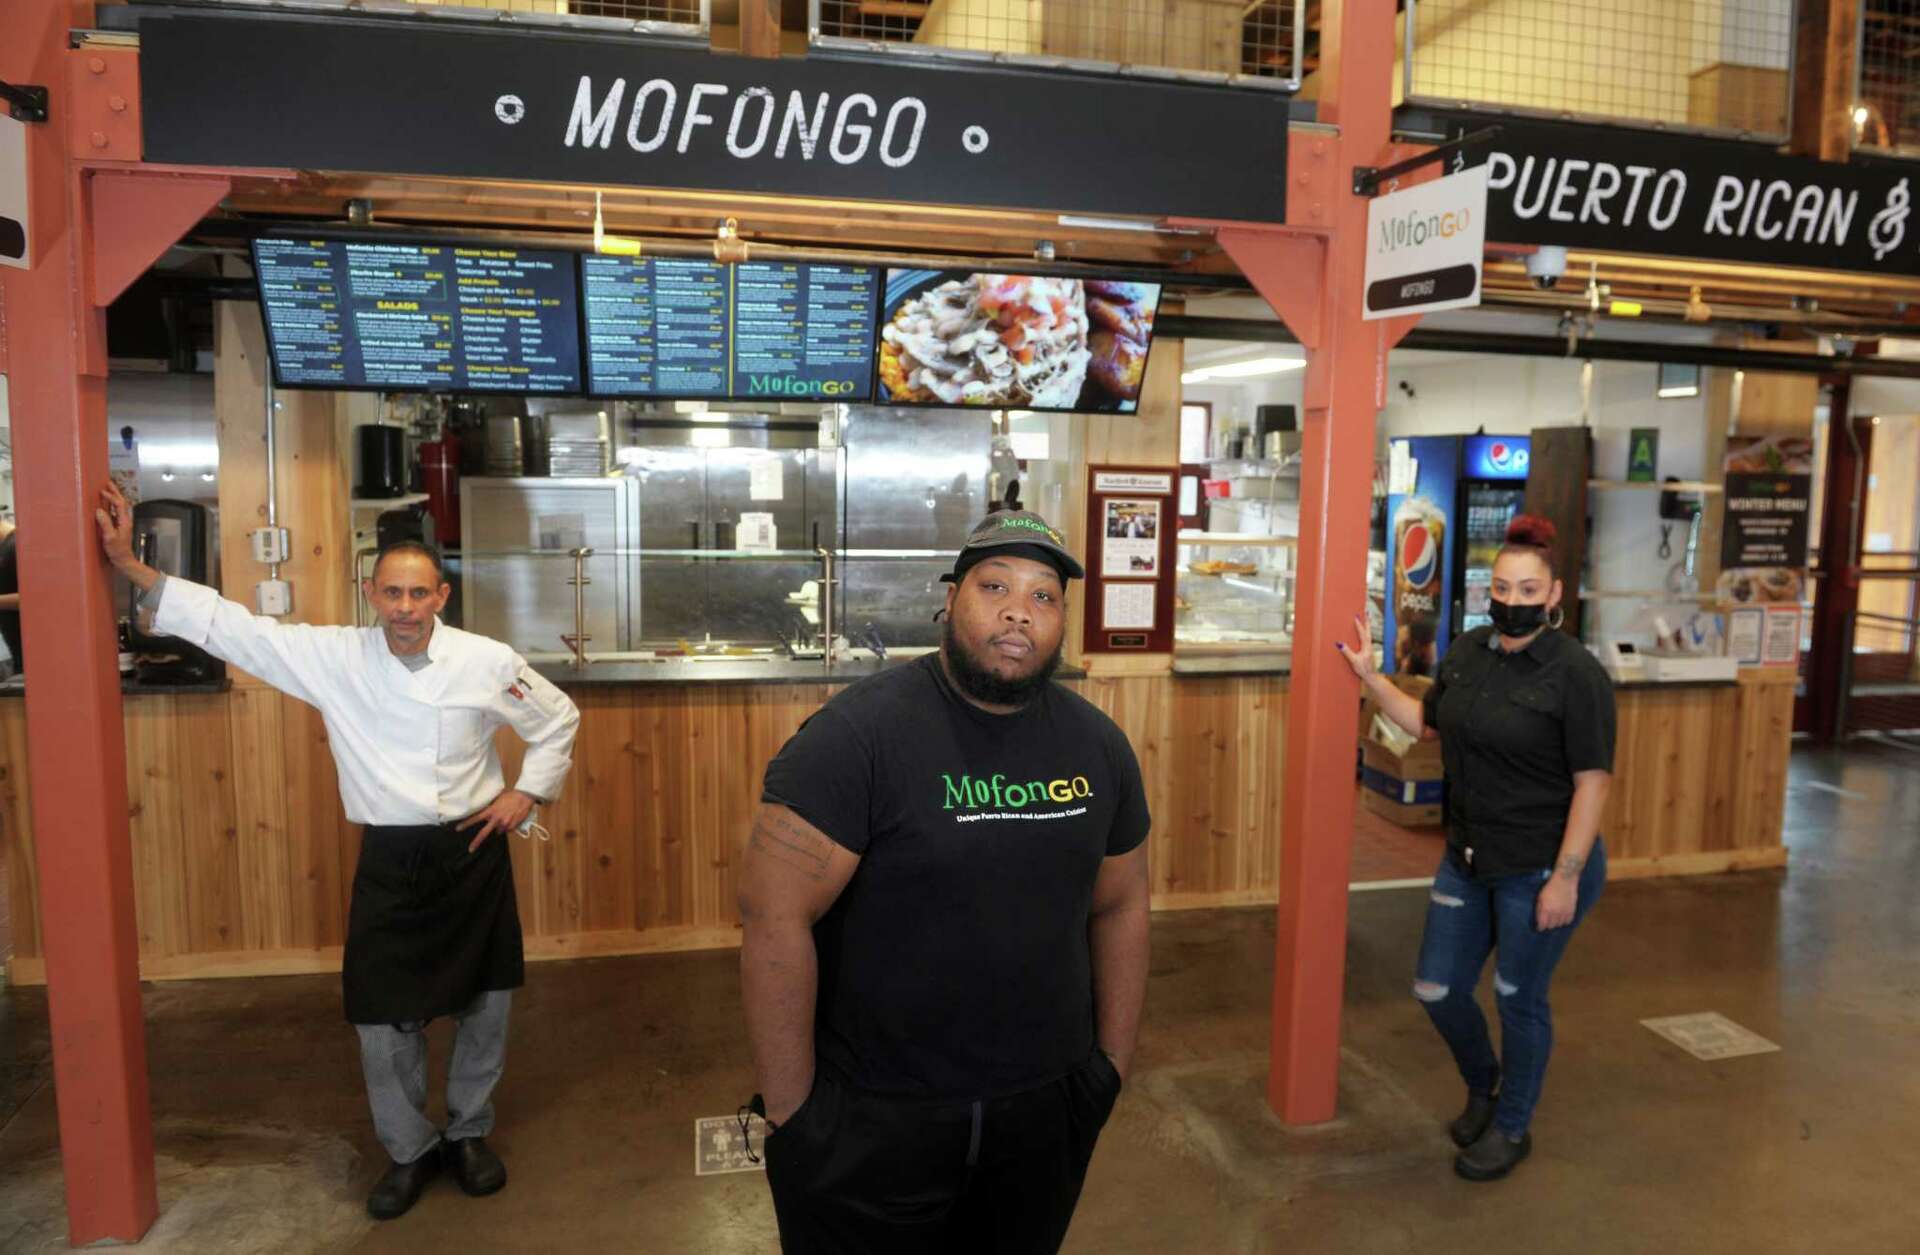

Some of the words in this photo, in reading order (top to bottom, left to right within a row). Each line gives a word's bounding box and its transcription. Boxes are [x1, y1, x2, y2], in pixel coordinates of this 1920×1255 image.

[564, 75, 927, 168] MOFONGO
[1487, 151, 1687, 230] PUERTO
[1704, 175, 1858, 247] RICAN
[376, 301, 419, 311] SALADS
[1728, 498, 1774, 512] WINTER
[1775, 499, 1808, 512] MENU
[956, 814, 981, 823] Unique
[981, 812, 1001, 820] Puerto
[1034, 812, 1066, 820] American
